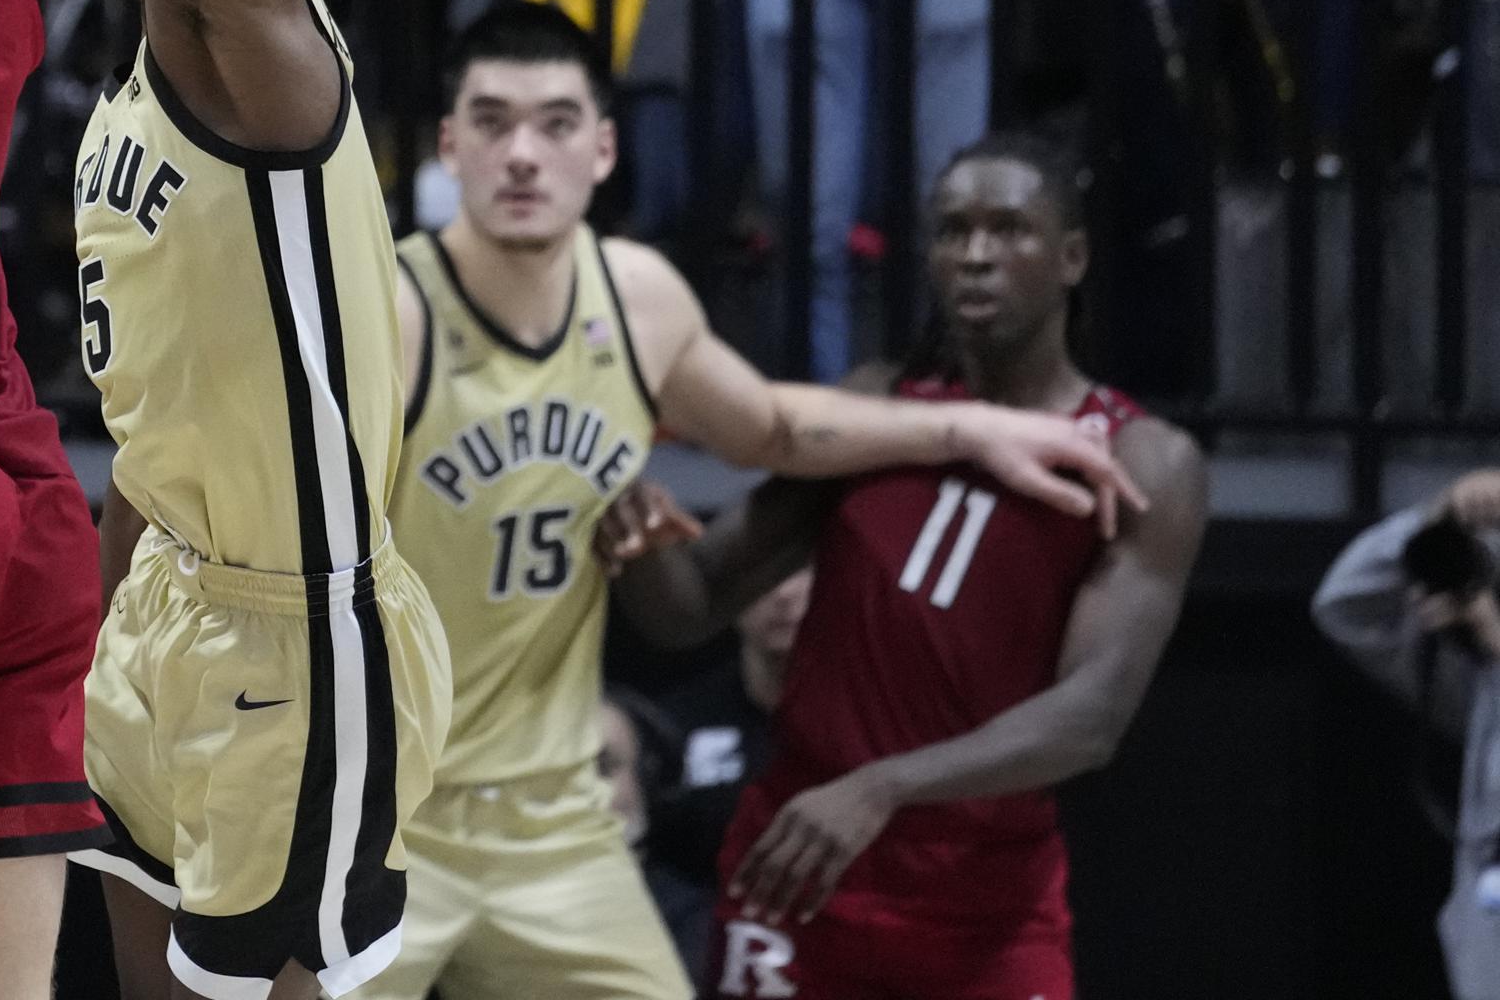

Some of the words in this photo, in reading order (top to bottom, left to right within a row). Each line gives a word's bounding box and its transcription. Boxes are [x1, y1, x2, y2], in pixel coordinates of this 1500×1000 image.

[422, 398, 636, 509] PURDUE
[490, 506, 573, 597] 15
[898, 478, 997, 610] 11
[718, 921, 797, 998] R
